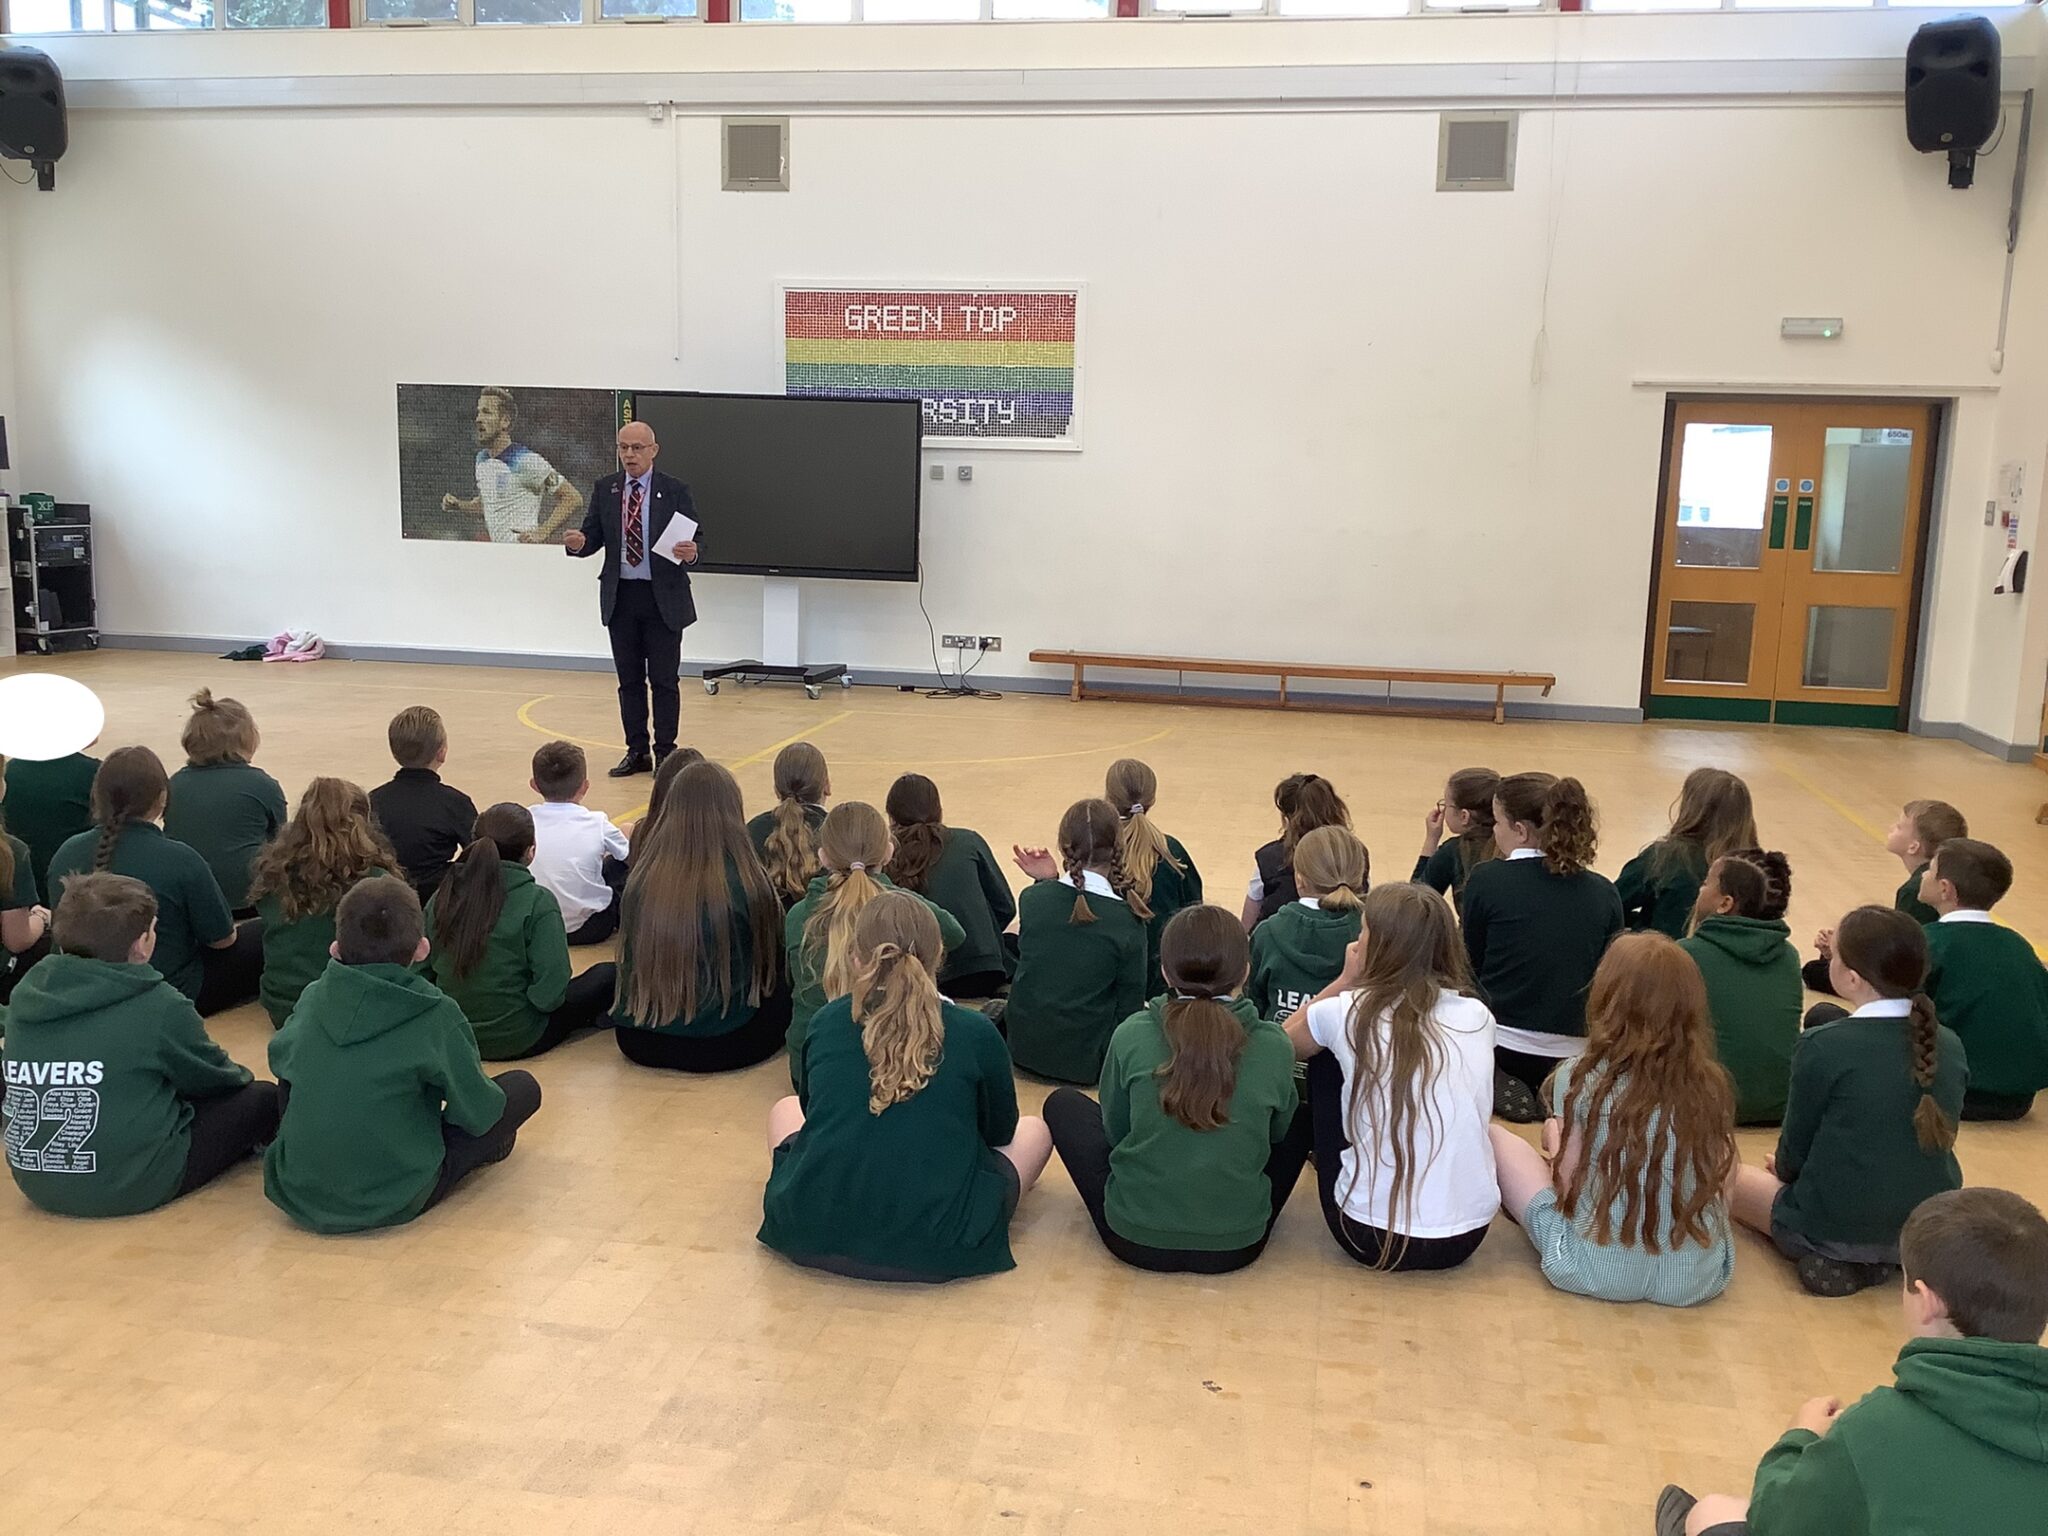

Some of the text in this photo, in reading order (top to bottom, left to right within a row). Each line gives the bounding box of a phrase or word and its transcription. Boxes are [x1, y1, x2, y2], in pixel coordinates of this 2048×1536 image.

[845, 304, 1016, 332] GREEN TOP
[1277, 989, 1316, 1011] LEA
[2, 1060, 104, 1085] LEAVERS
